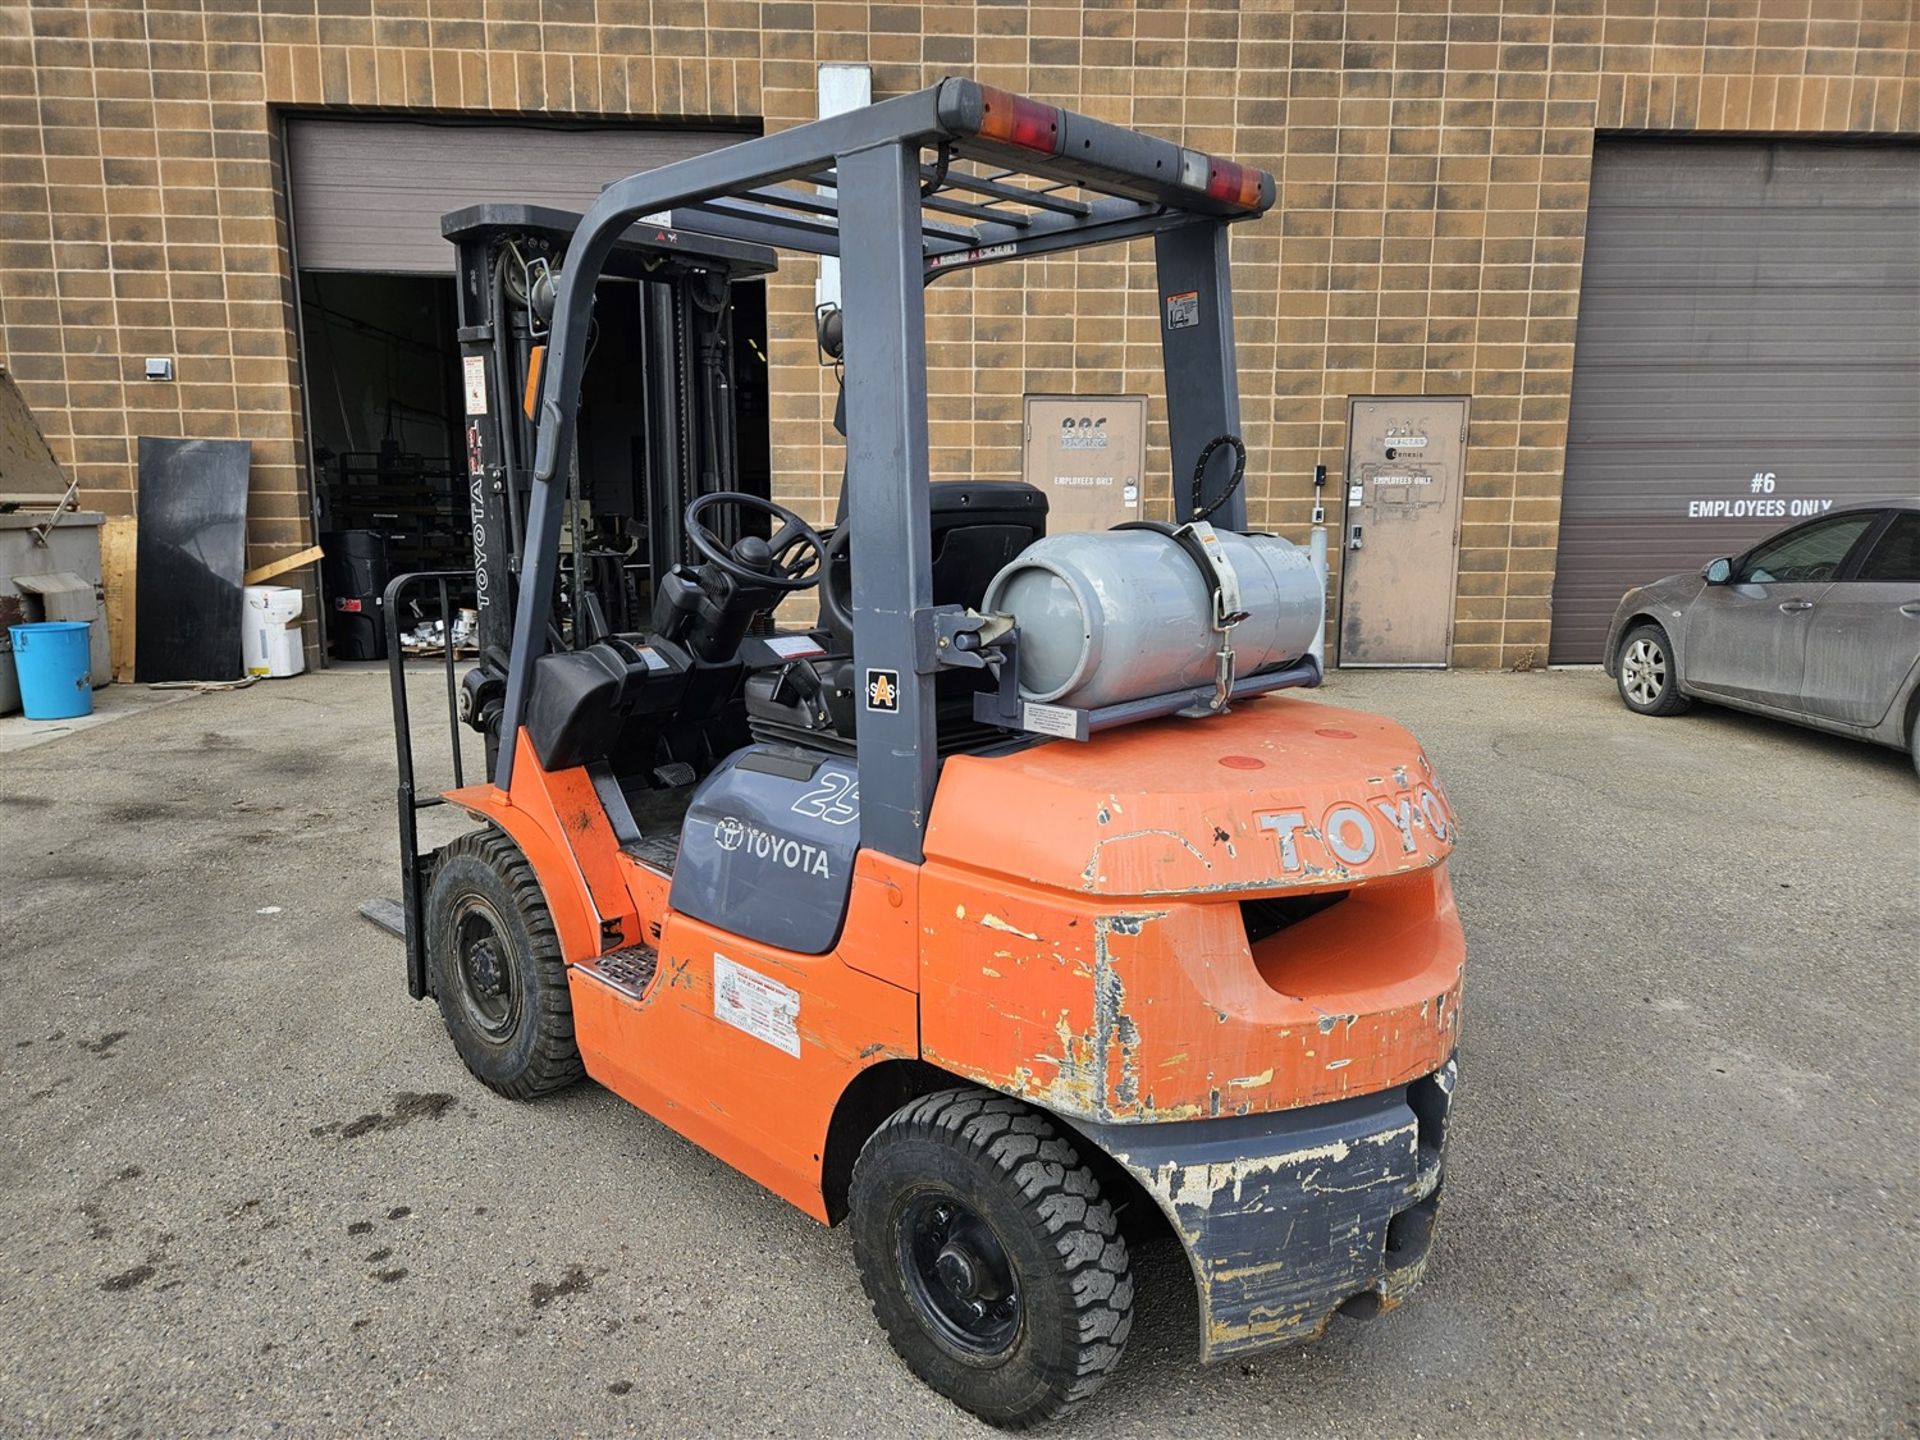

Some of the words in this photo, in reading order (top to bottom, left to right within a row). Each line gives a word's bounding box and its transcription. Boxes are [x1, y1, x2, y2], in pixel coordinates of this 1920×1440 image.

[1054, 476, 1093, 485] EMPLOYEES
[1372, 475, 1412, 485] EMPLOYEES
[1750, 472, 1776, 493] #6
[1688, 500, 1786, 517] EMPLOYEES
[471, 479, 489, 610] TOYOTA
[746, 827, 829, 879] TOYOTA
